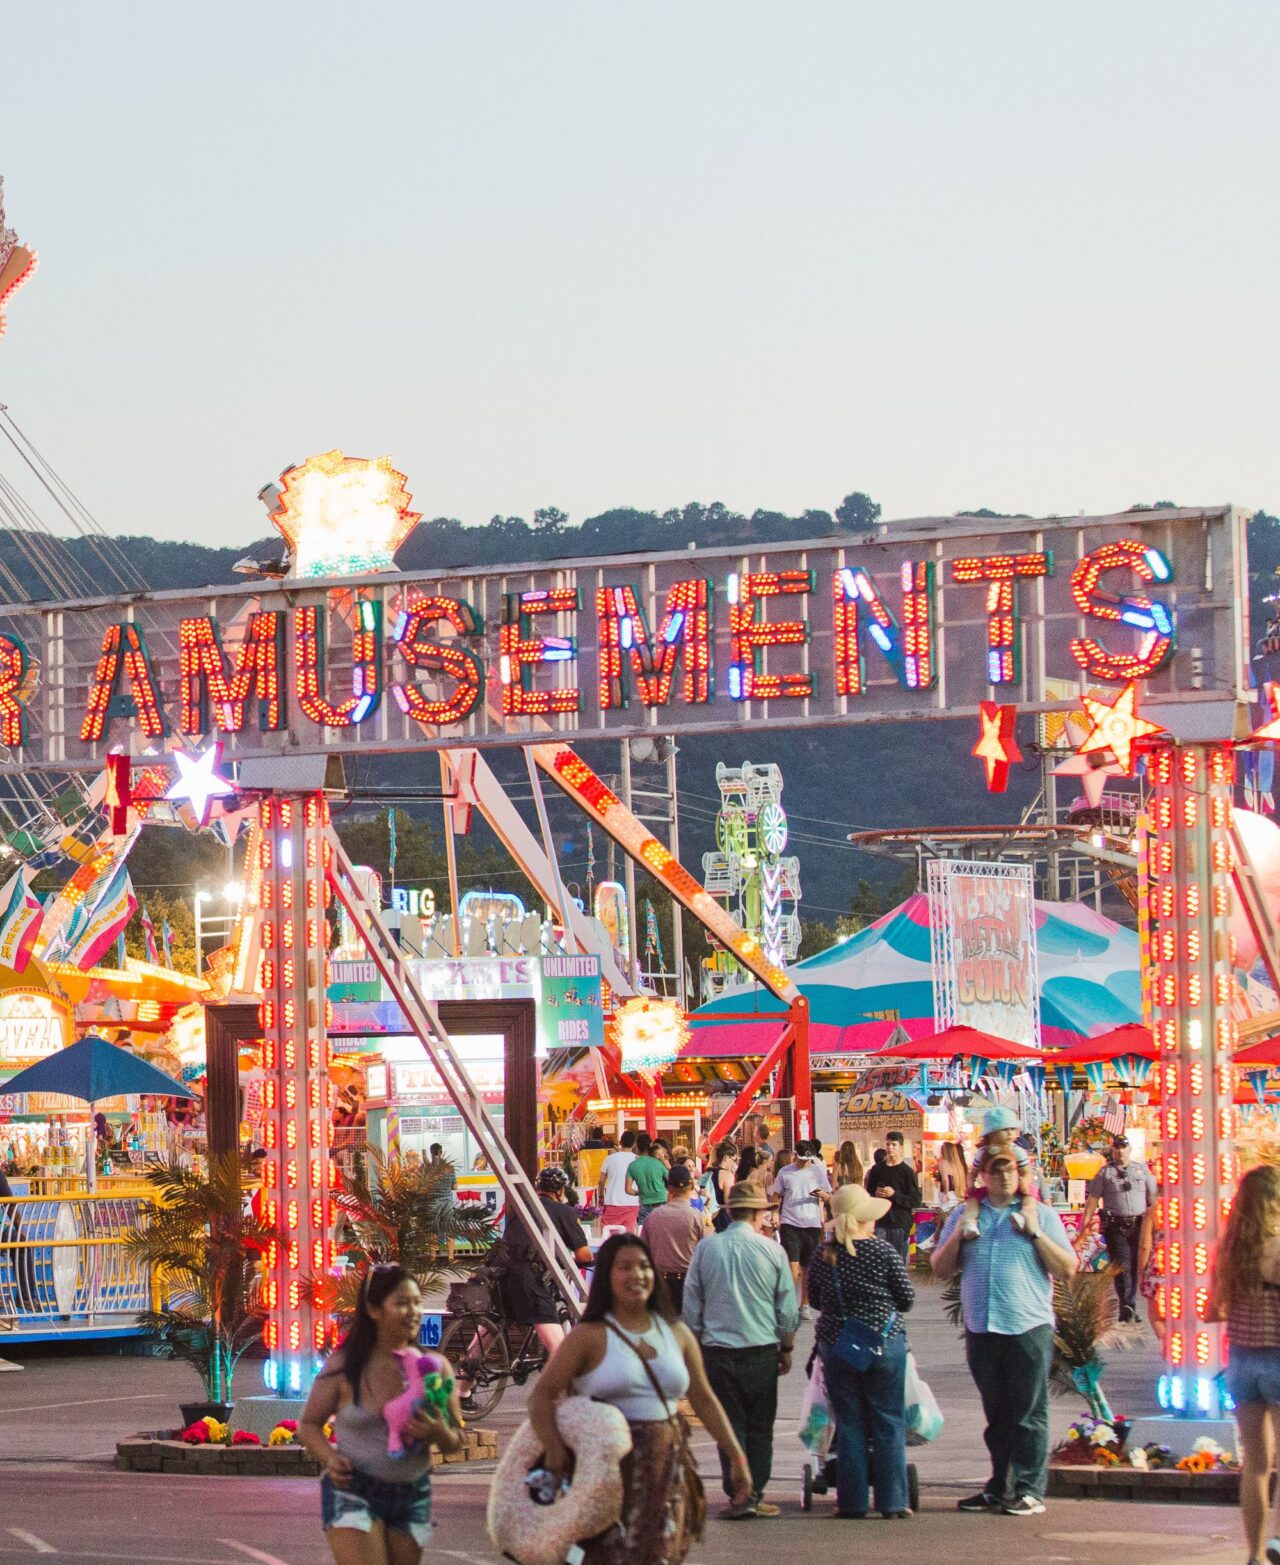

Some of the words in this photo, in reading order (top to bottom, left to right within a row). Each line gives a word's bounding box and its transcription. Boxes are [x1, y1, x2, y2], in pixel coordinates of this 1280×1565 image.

[78, 539, 1174, 741] AMUSEMENTS
[392, 888, 435, 916] BIG
[961, 915, 1022, 962] KETTLE
[543, 957, 598, 977] UNLIMITED
[958, 958, 1029, 1008] CORN
[559, 1020, 589, 1041] RIDES
